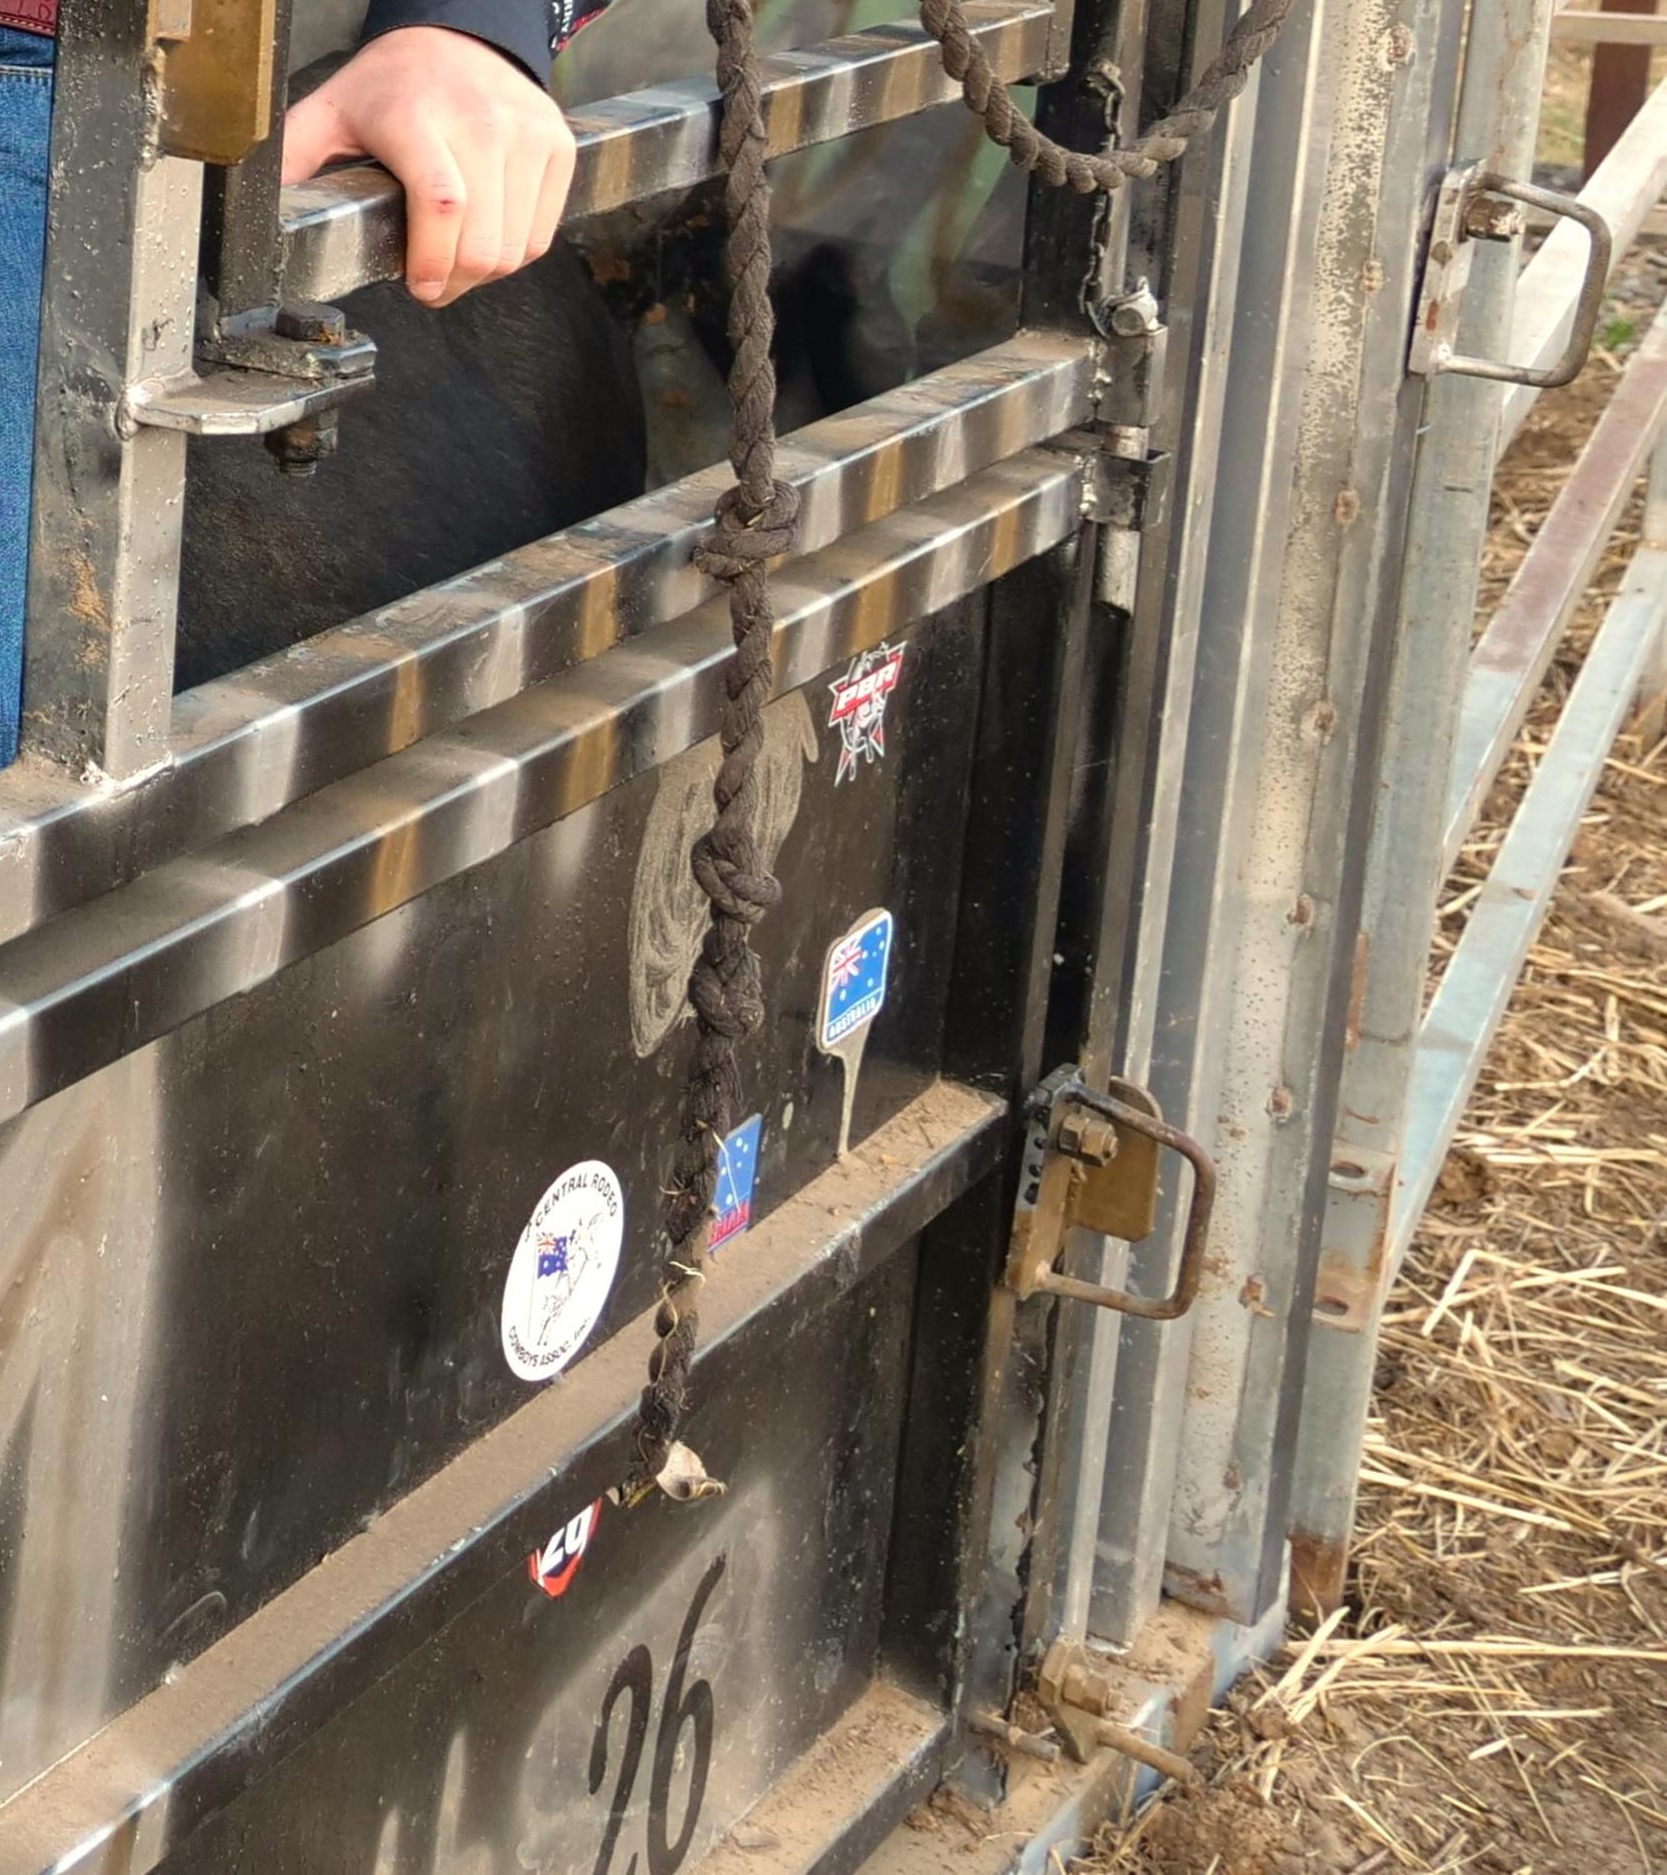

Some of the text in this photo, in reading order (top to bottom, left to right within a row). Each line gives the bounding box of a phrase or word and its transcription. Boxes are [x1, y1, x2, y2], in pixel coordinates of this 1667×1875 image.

[836, 661, 898, 711] PBR
[535, 1172, 618, 1227] CENTRAL RODEO
[588, 1548, 727, 1875] 26
